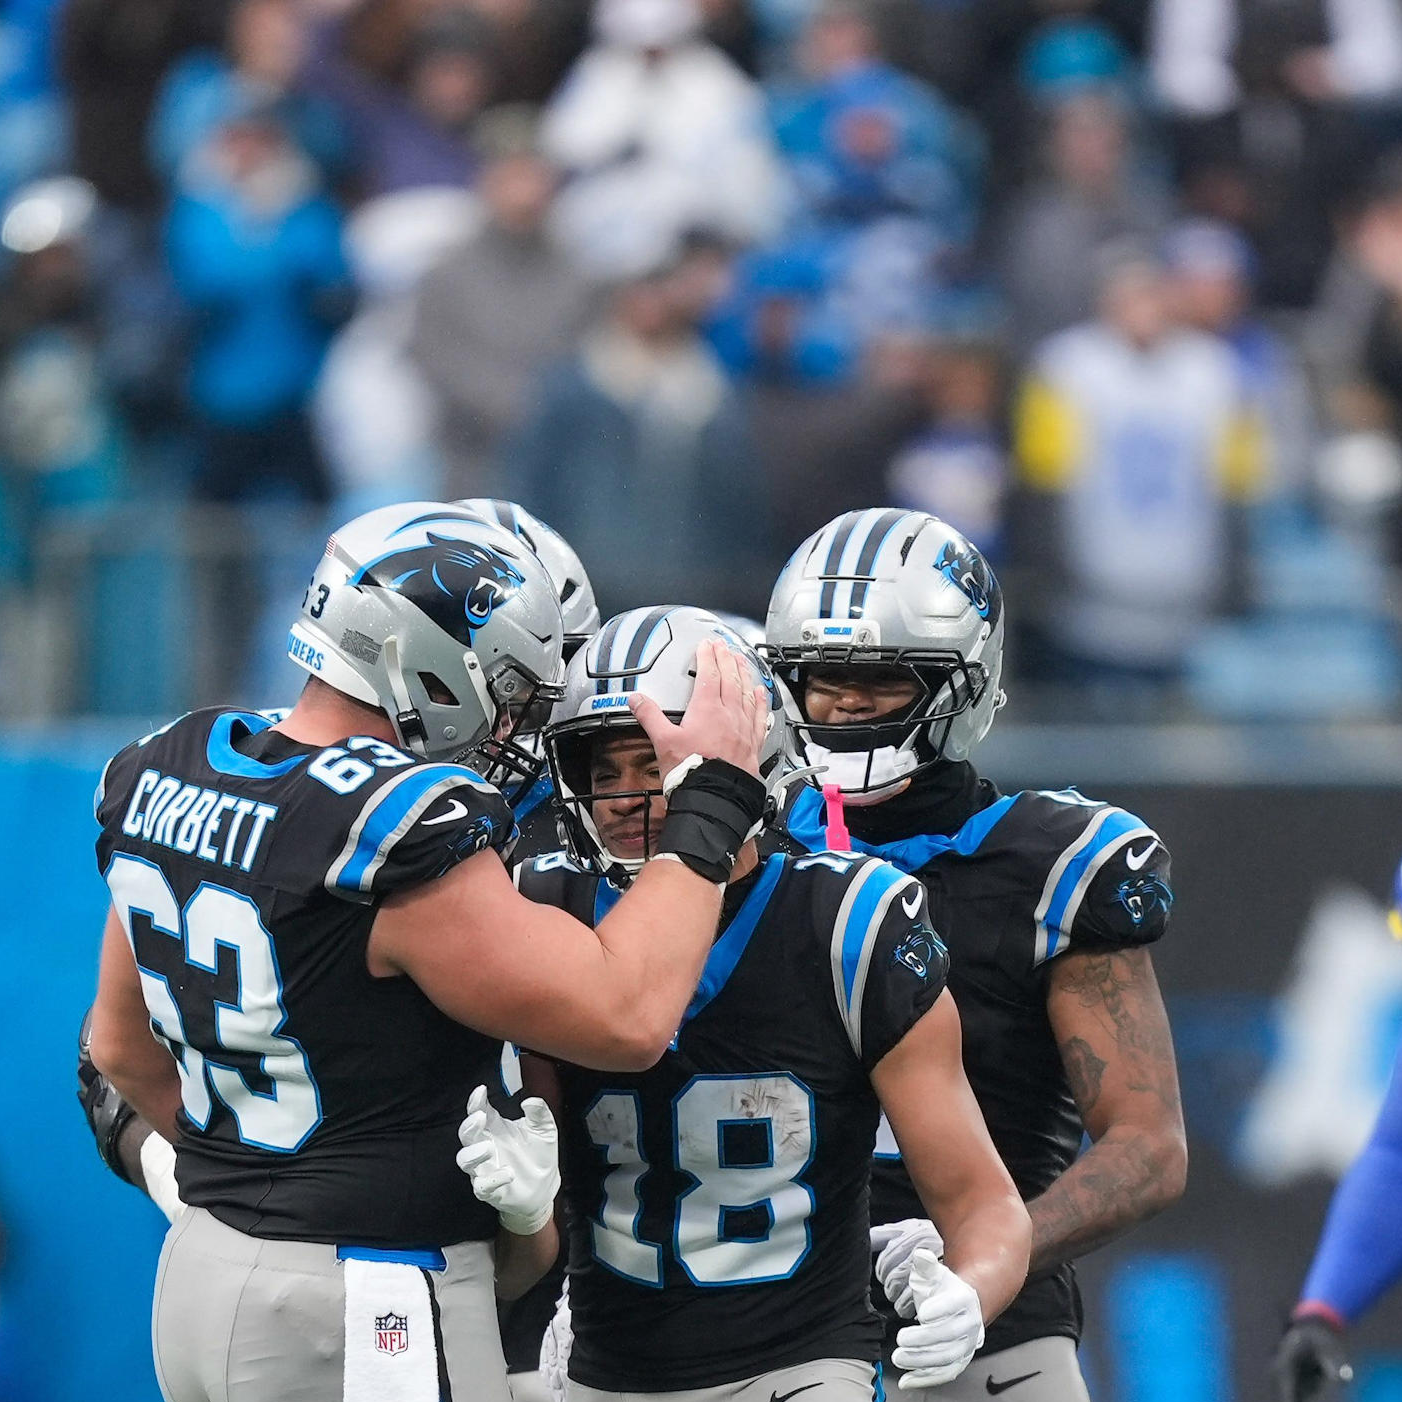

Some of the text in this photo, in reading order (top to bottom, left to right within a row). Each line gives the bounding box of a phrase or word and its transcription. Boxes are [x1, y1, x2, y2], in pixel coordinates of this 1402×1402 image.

[306, 735, 416, 795] 63
[121, 768, 279, 872] CORBETT
[101, 849, 324, 1154] 63
[585, 1070, 816, 1289] 18
[378, 1331, 406, 1352] NFL
